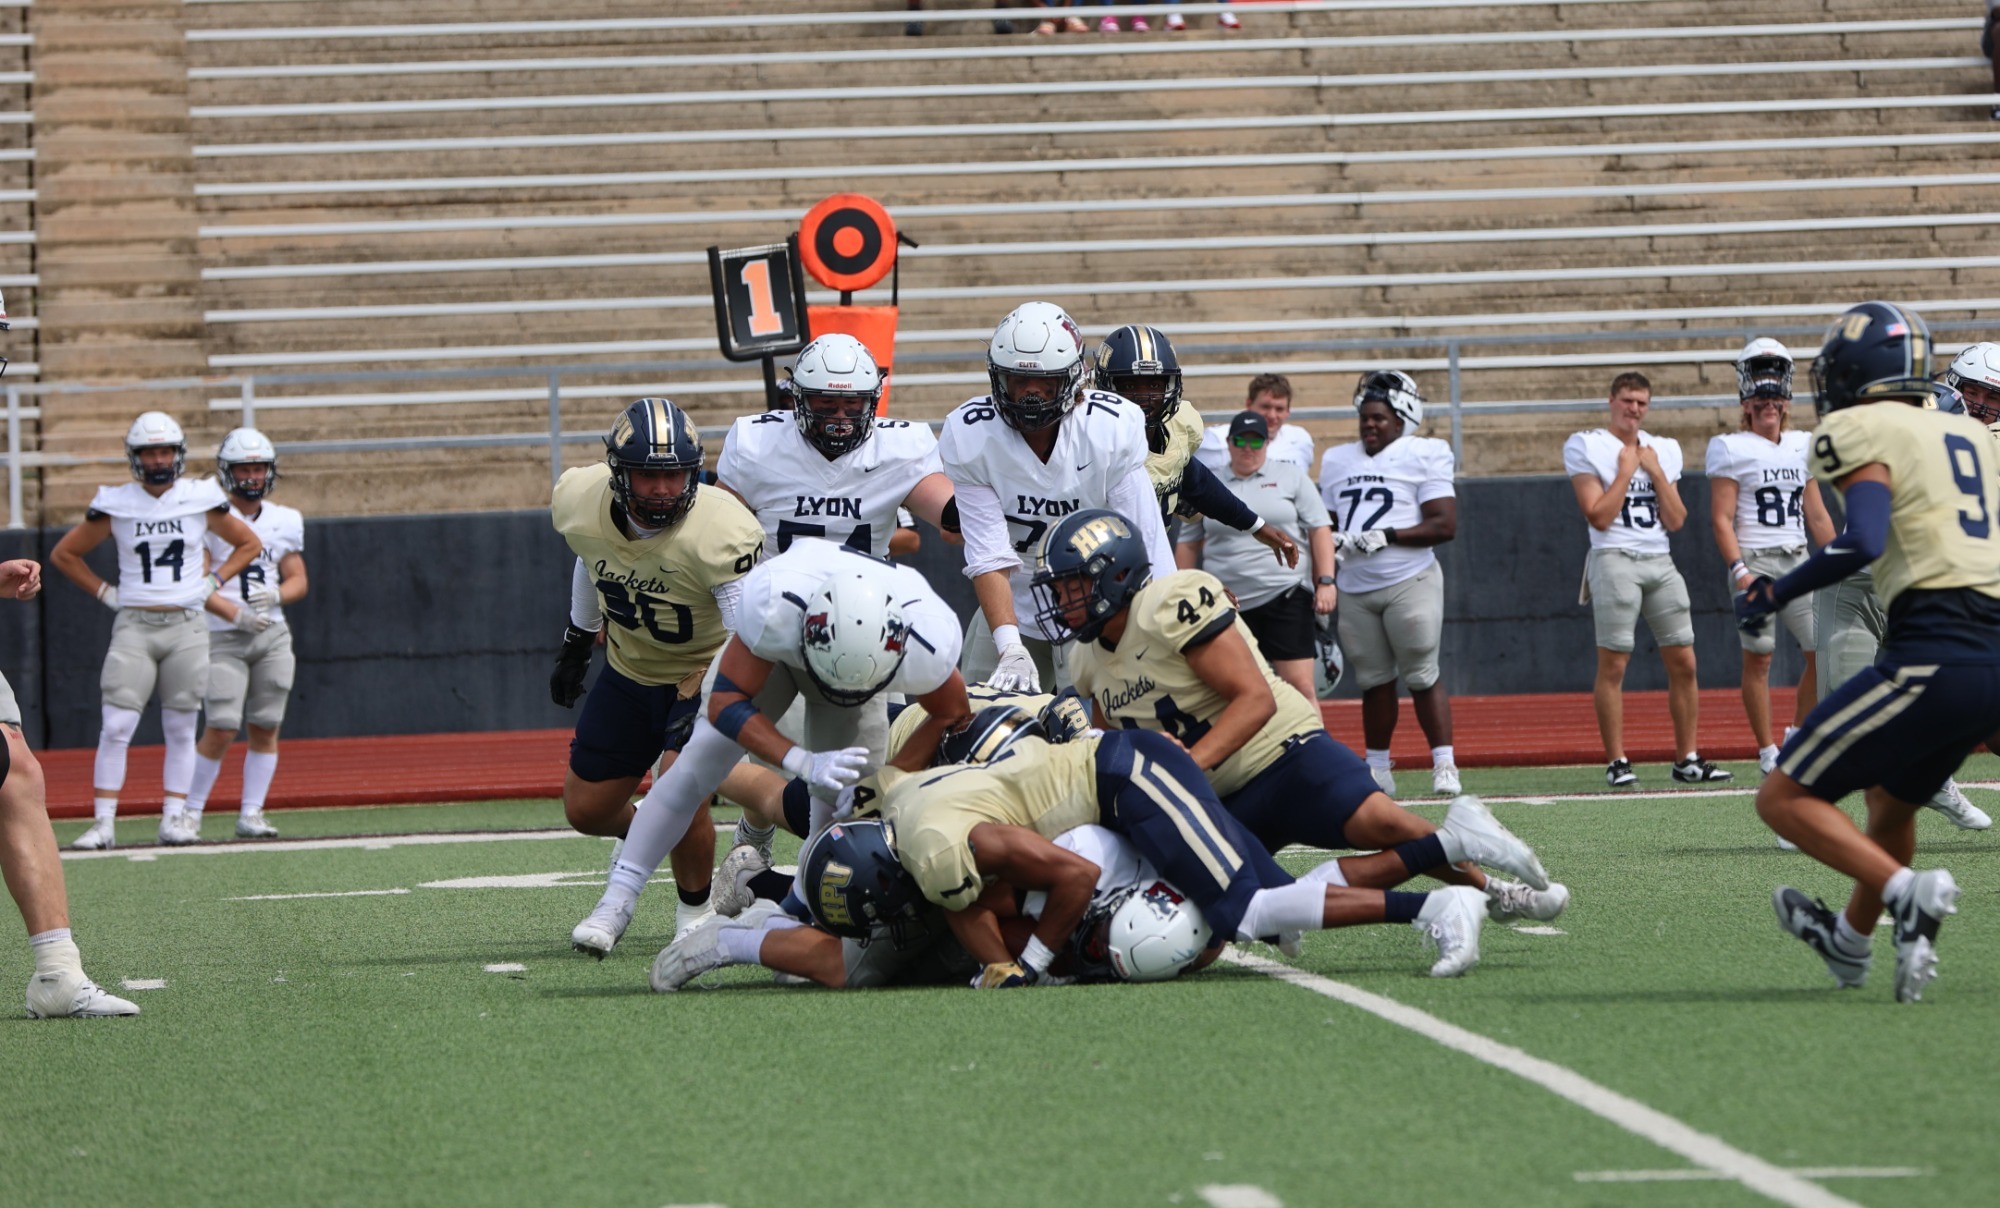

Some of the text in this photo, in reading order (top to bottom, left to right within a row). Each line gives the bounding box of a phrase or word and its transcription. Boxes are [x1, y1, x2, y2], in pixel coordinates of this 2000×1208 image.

[741, 259, 784, 338] 1
[1086, 392, 1122, 418] 78
[1815, 434, 1842, 473] 9
[1763, 468, 1801, 484] LYON
[1944, 432, 1990, 539] 9
[794, 496, 862, 520] LYON
[1017, 494, 1080, 517] LYON
[1340, 487, 1394, 532] 72
[1755, 486, 1805, 528] 84
[135, 520, 184, 537] LYON
[1069, 516, 1132, 563] HPU
[134, 539, 185, 583] 14
[595, 559, 670, 594] Jackets
[1052, 696, 1094, 741] HP
[1102, 675, 1155, 720] Jackets
